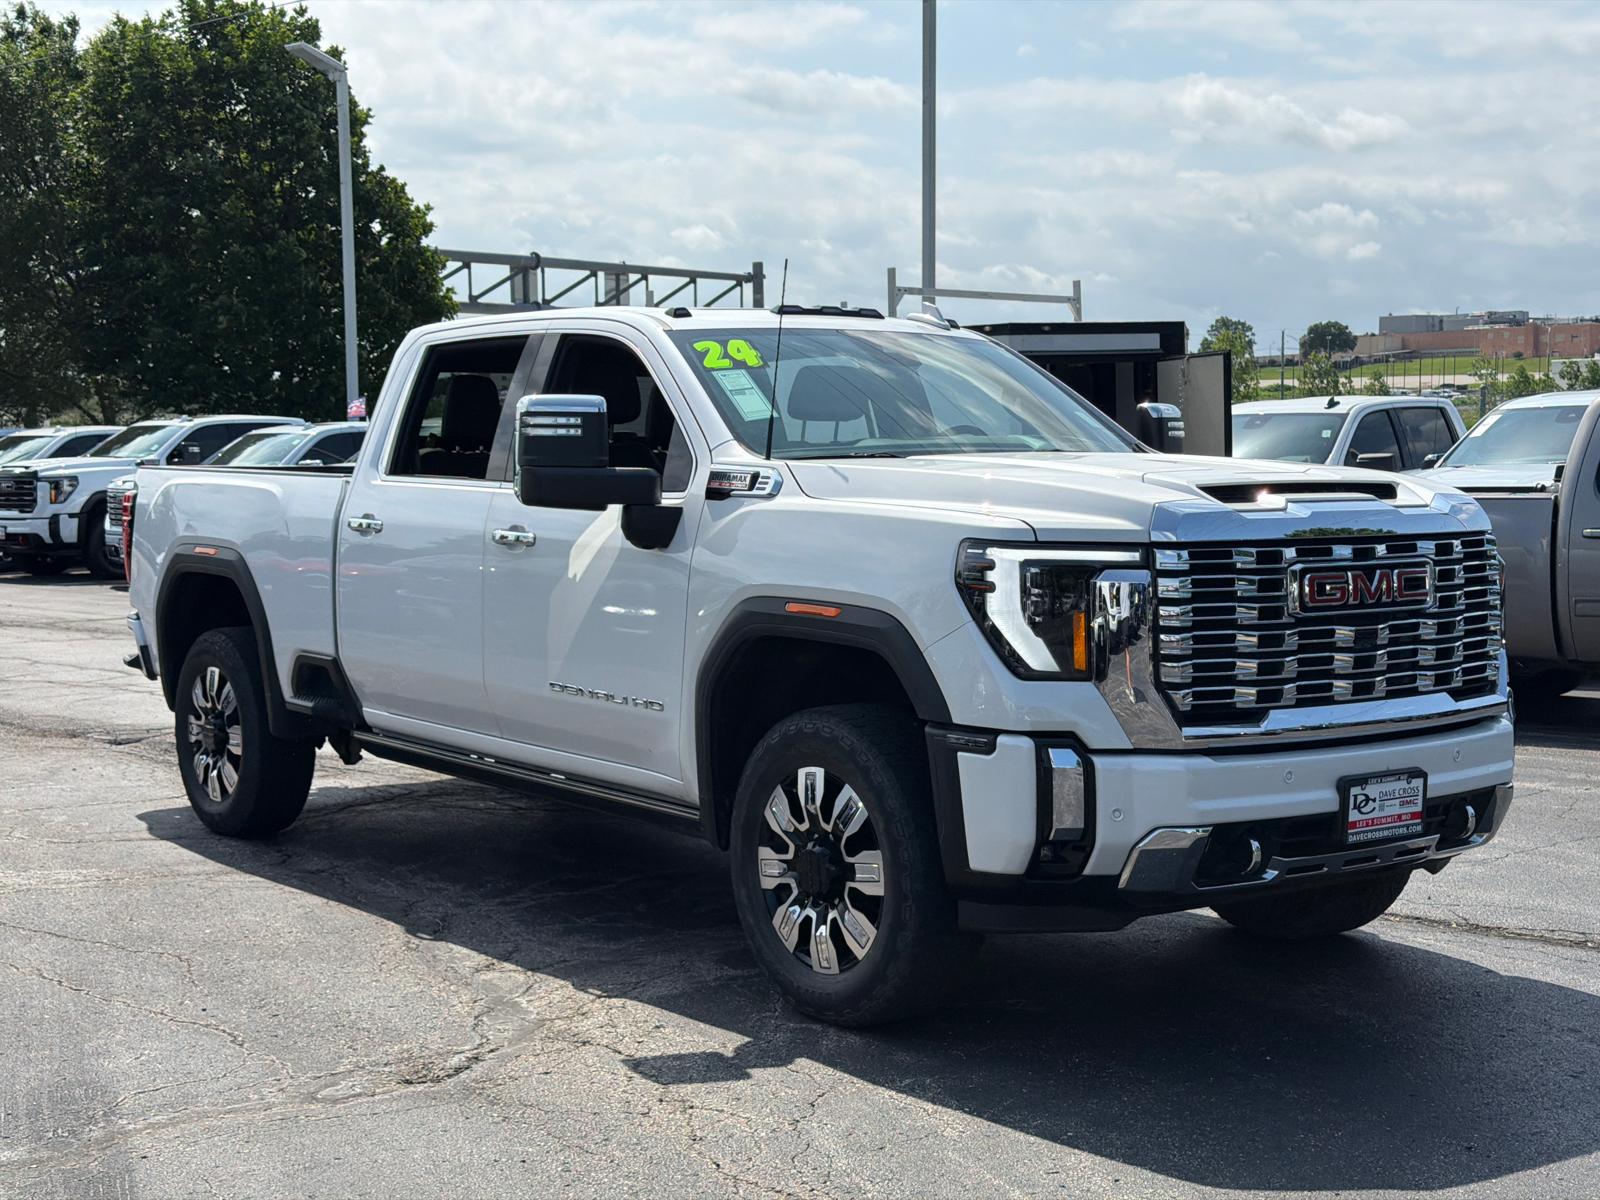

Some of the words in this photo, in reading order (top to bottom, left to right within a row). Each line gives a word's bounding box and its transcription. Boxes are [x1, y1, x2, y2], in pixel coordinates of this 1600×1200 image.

[693, 339, 764, 369] 24
[711, 473, 748, 482] DURAMAX
[1304, 568, 1429, 607] GMC
[549, 681, 628, 705] DENALI
[632, 696, 664, 712] HD
[1379, 789, 1397, 799] DAVE
[1398, 786, 1420, 797] CROSS
[1399, 798, 1419, 807] GMC
[1356, 819, 1372, 828] LEE'S
[1373, 815, 1400, 825] SUMMIT,
[1401, 813, 1411, 821] MO
[1348, 825, 1422, 842] DAVECROSSMOTORS.COM
